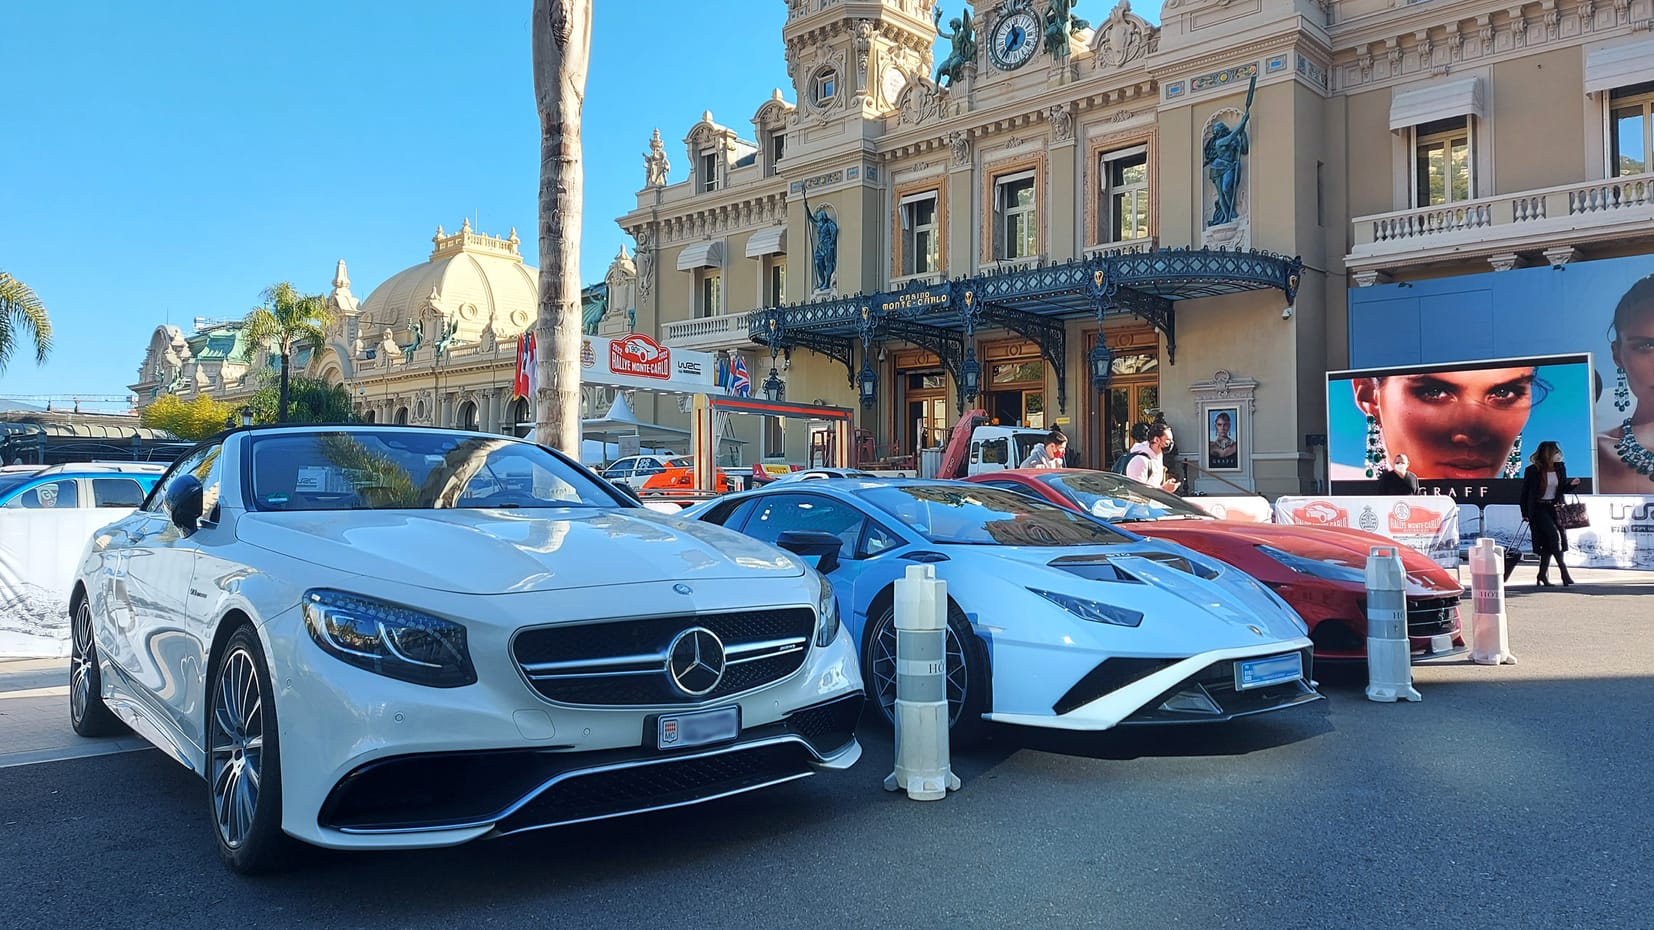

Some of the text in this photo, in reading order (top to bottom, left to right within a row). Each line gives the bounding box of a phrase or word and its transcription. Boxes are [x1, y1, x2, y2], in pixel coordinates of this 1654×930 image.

[612, 351, 668, 376] RALLYE MONTE-CARLO
[677, 360, 701, 371] WRC
[1418, 486, 1489, 497] GRAFF
